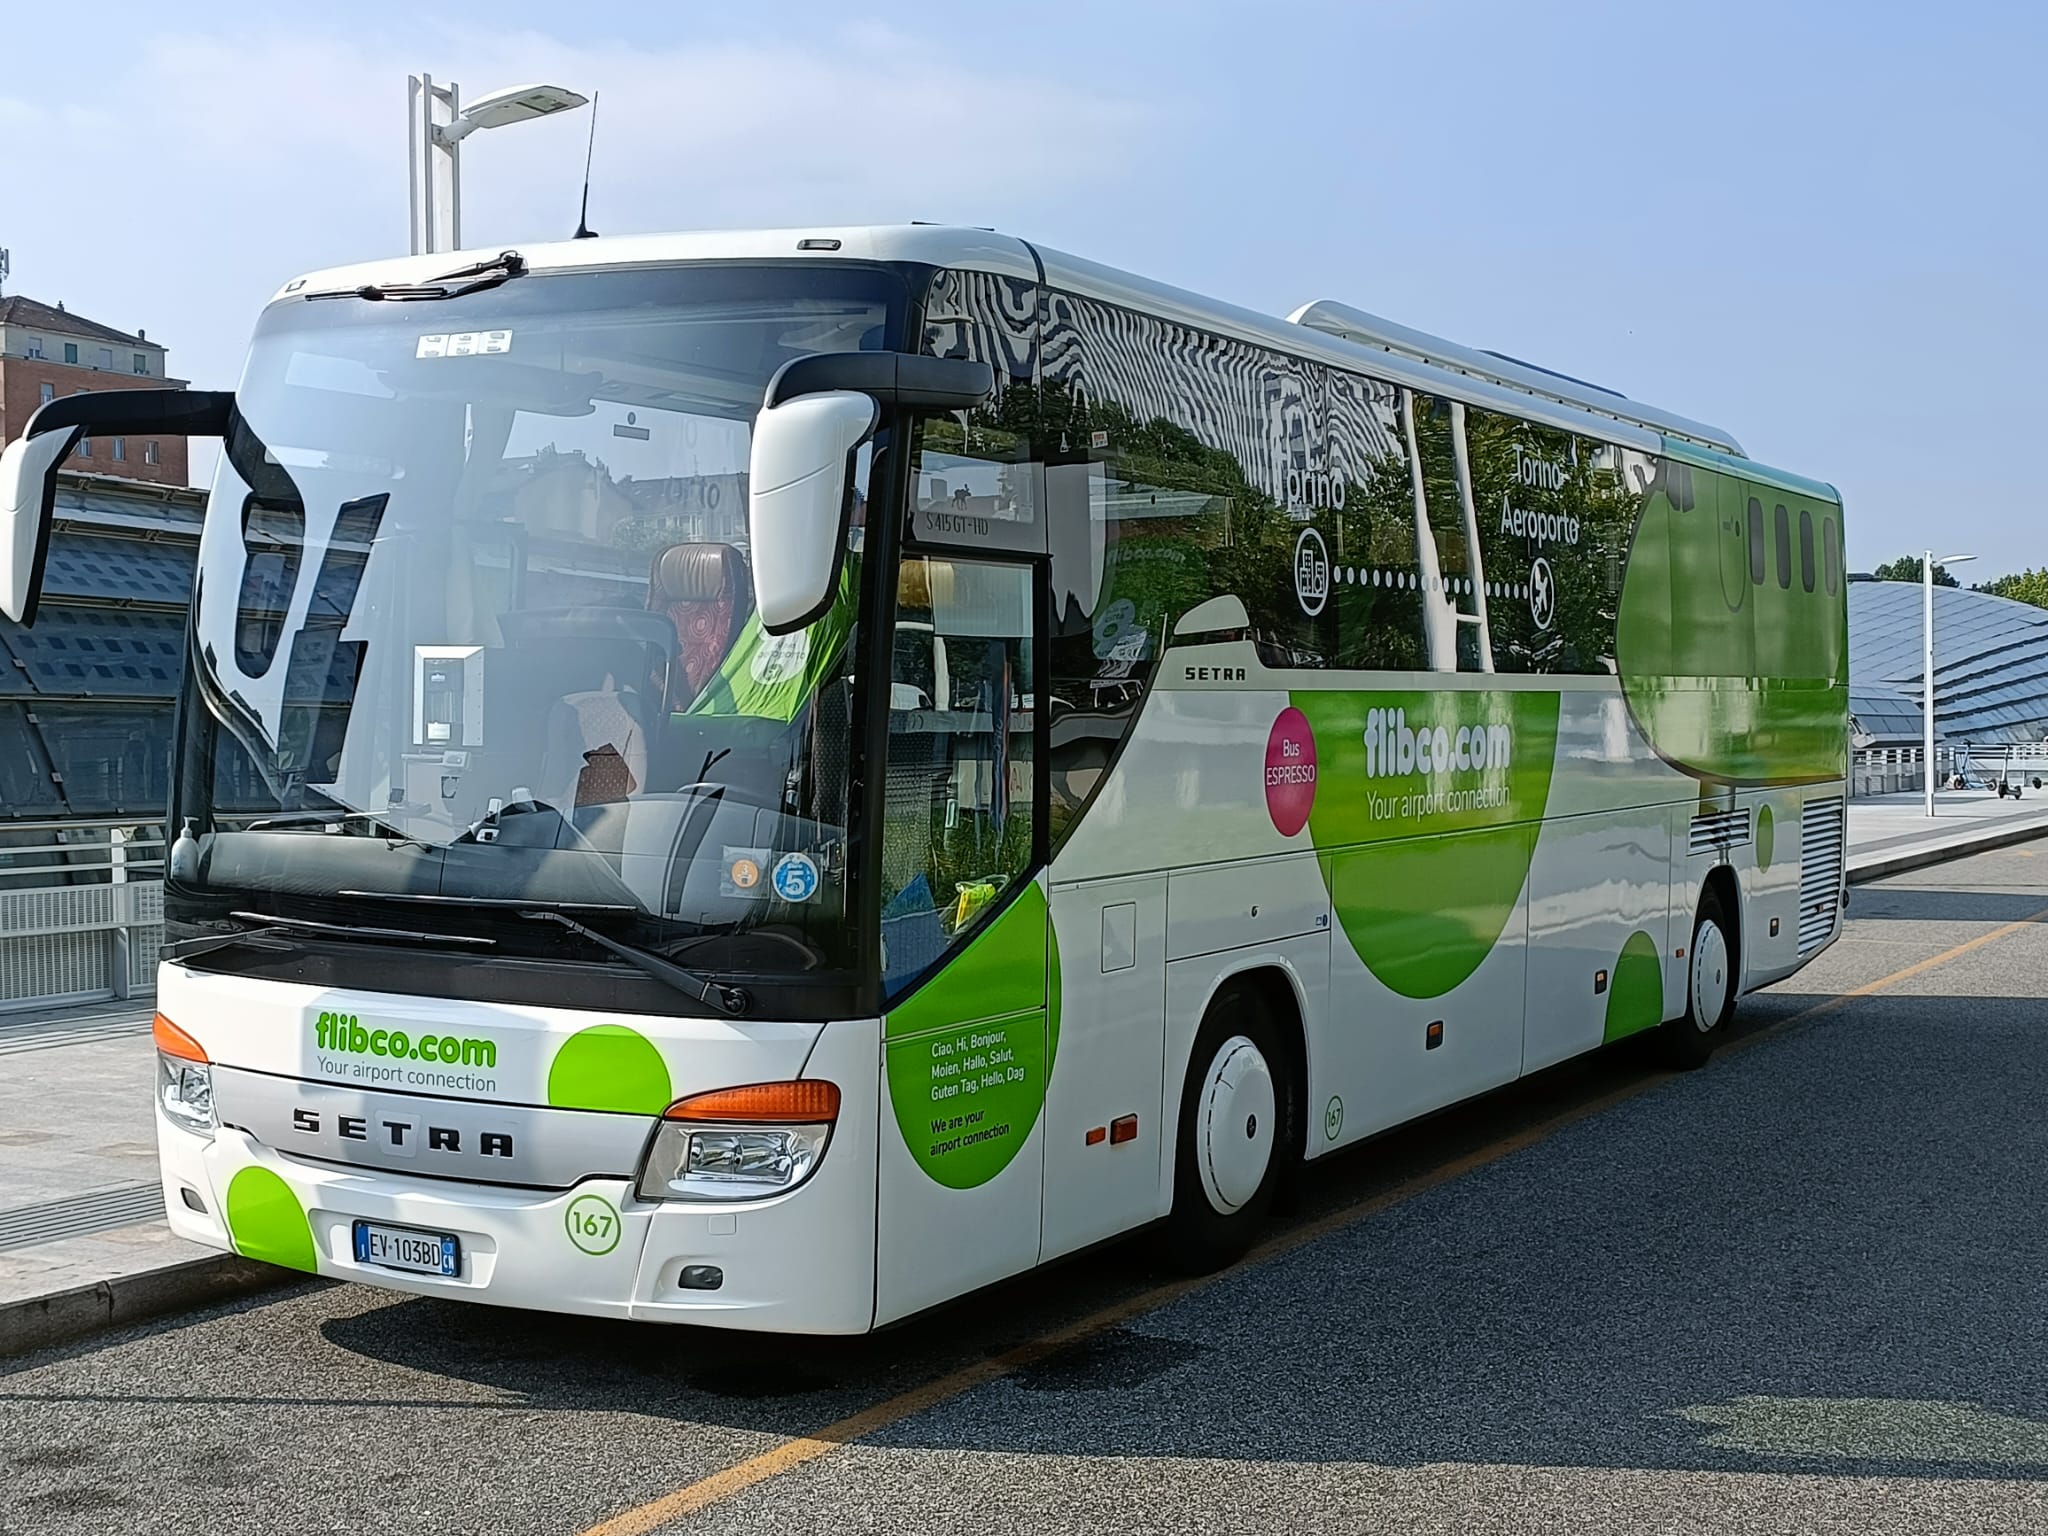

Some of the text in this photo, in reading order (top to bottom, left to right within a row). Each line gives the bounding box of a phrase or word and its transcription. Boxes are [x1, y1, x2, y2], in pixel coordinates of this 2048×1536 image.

[1513, 443, 1563, 490] Torino
[926, 511, 989, 536] S 415 GT-HD
[1501, 496, 1579, 548] Aeroporto
[1185, 667, 1246, 681] SETRA
[1283, 739, 1301, 757] Bus
[1363, 707, 1512, 779] flibco.com
[1266, 764, 1316, 786] ESPRESSO
[1366, 784, 1511, 823] Your airport connection
[315, 1012, 497, 1068] flibco.com
[931, 1030, 1007, 1058] Ciao, Hi, Bonjour,
[317, 1055, 497, 1093] Your airport connection
[931, 1047, 1014, 1080] Moien, Hallo, Salut,
[931, 1065, 1025, 1101] Guten Tag, Hello, Dag
[293, 1107, 513, 1158] SETRA
[930, 1109, 985, 1135] We are your
[1328, 1108, 1340, 1128] 167
[930, 1123, 1010, 1157] airport connection
[573, 1210, 613, 1239] 167
